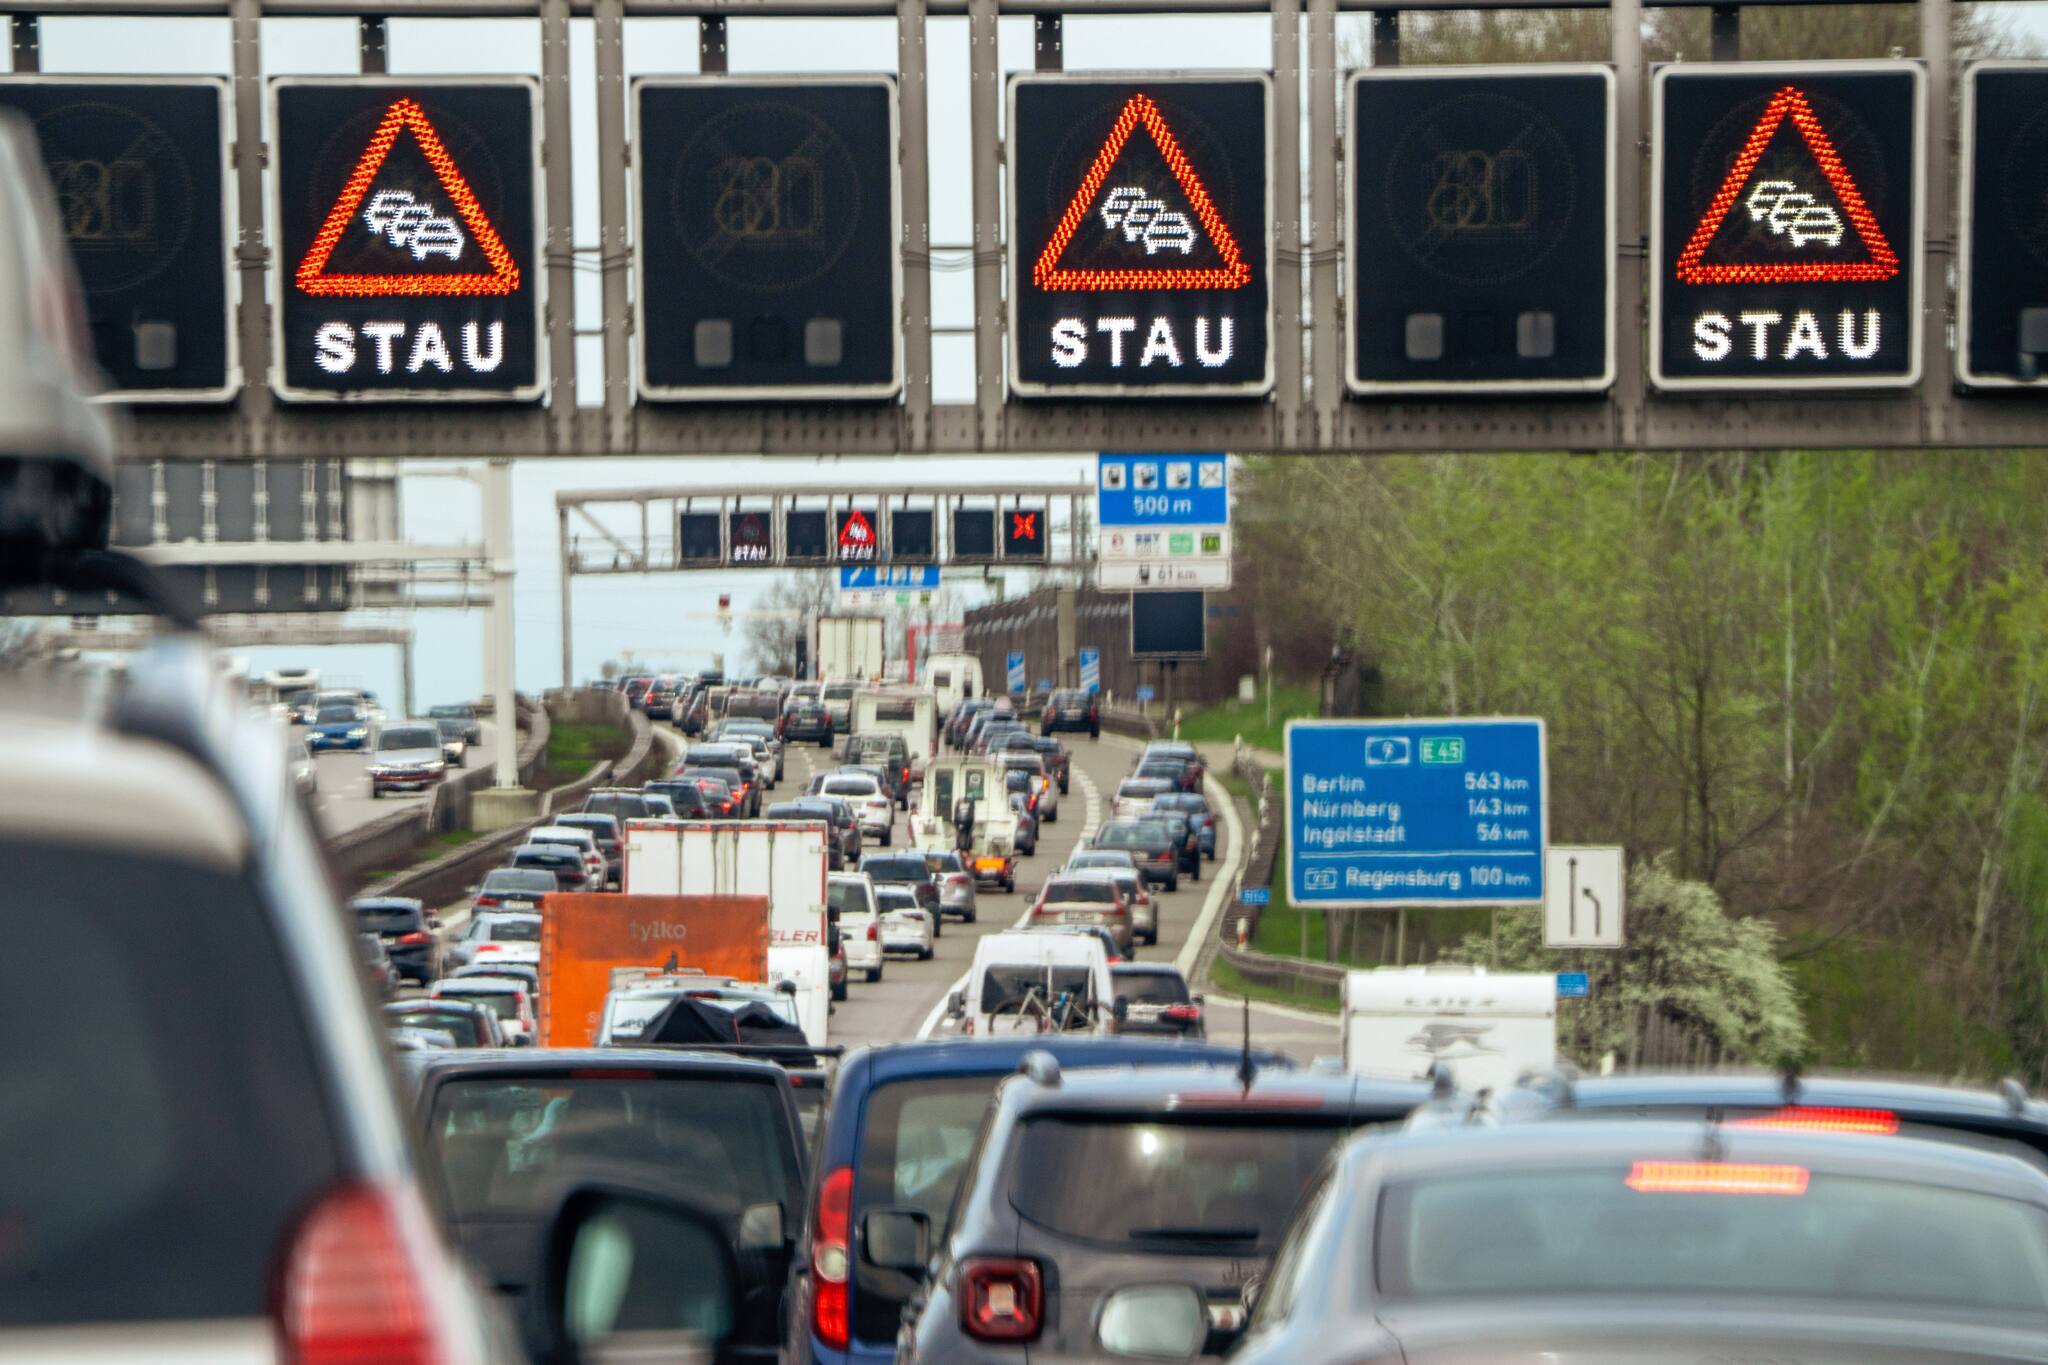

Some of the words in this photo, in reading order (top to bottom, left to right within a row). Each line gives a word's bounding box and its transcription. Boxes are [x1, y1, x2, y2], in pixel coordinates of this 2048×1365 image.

[1051, 317, 1234, 367] STAU
[1693, 308, 1881, 360] STAU
[313, 321, 504, 374] STAU
[1134, 495, 1169, 516] 500
[1173, 499, 1191, 513] m
[1424, 741, 1434, 760] E
[1438, 741, 1461, 761] 45
[1303, 774, 1366, 793] Berlin
[1504, 776, 1529, 790] km
[1303, 798, 1401, 821] Nürnberg
[1469, 798, 1501, 815] 143
[1504, 800, 1529, 815] km
[1304, 824, 1406, 848] Ingolstadt
[1476, 822, 1502, 841] 56
[1504, 826, 1529, 841] km
[1346, 867, 1462, 890] Regensburg
[1470, 866, 1503, 886] 100
[1505, 872, 1531, 886] km
[629, 919, 687, 944] tylko
